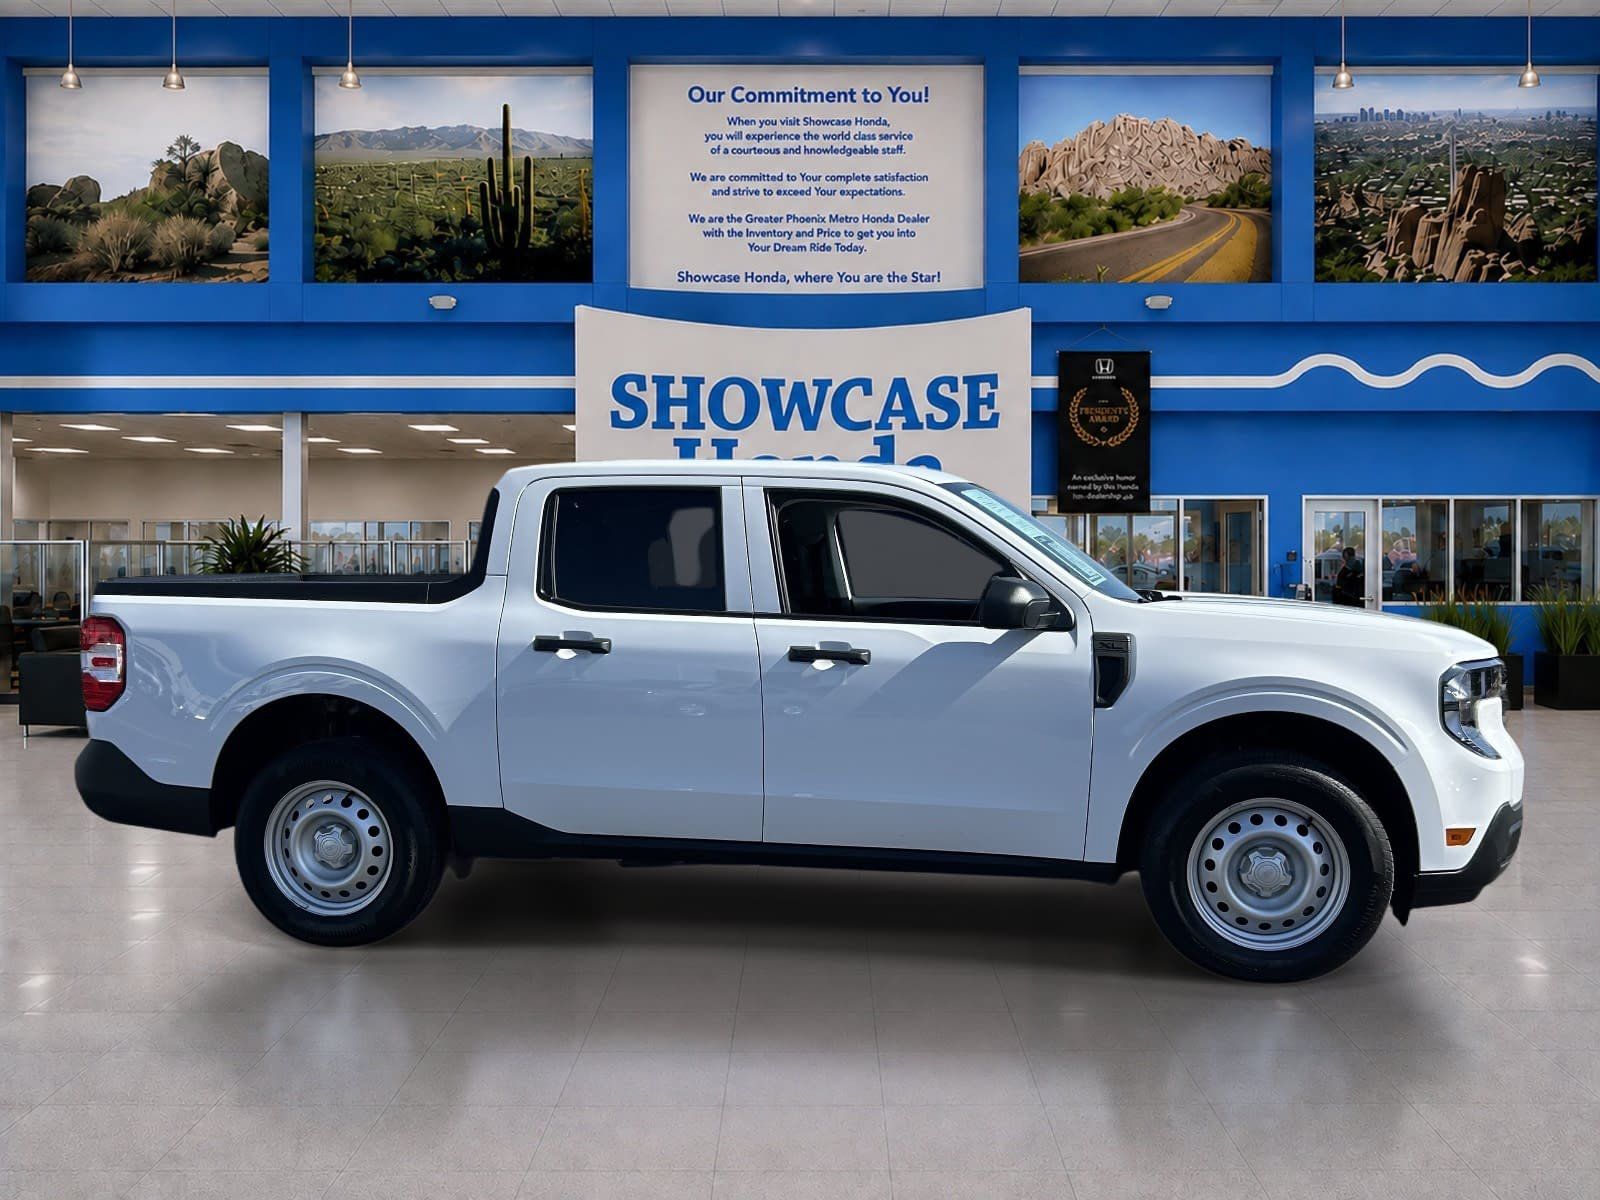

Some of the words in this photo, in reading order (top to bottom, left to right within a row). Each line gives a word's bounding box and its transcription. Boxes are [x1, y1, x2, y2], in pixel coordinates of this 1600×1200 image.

[687, 85, 726, 104] Our
[730, 85, 857, 104] Commitment
[860, 87, 883, 104] to
[886, 85, 930, 104] You!
[726, 116, 757, 127] When
[758, 118, 778, 128] you
[779, 116, 801, 127] visit
[802, 116, 853, 127] Showcase
[854, 116, 891, 128] Honda,
[704, 132, 724, 143] you
[725, 130, 743, 141] will
[745, 130, 801, 143] experience
[802, 130, 820, 141] the
[821, 130, 852, 141] world
[852, 130, 877, 142] class
[878, 130, 914, 142] service
[709, 144, 721, 155] of
[722, 146, 730, 156] a
[730, 146, 781, 156] courteous
[782, 144, 802, 155] and
[881, 144, 906, 155] staff.
[689, 172, 708, 183] We
[709, 174, 727, 182] are
[728, 171, 784, 183] committed
[785, 173, 798, 183] to
[799, 172, 823, 183] Your
[824, 172, 872, 185] complete
[873, 171, 929, 183] satisfaction
[711, 185, 731, 197] and
[732, 186, 761, 197] strive
[762, 187, 774, 197] to
[775, 186, 812, 197] exceed
[813, 186, 838, 197] Your
[839, 186, 906, 200] expectations.
[688, 213, 707, 224] We
[707, 215, 725, 224] are
[726, 213, 743, 224] the
[744, 213, 784, 224] Greater
[785, 213, 827, 224] Phoenix
[828, 213, 860, 224] Metro
[861, 213, 895, 224] Honda
[897, 213, 931, 224] Dealer
[702, 227, 725, 238] with
[726, 227, 744, 238] the
[745, 227, 794, 241] Inventory
[795, 227, 815, 239] and
[816, 227, 842, 239] Price
[843, 229, 855, 238] to
[856, 229, 874, 241] get
[875, 229, 895, 241] you
[896, 227, 917, 239] into
[747, 242, 772, 253] Your
[773, 242, 808, 253] Dream
[809, 242, 833, 253] Ride
[834, 242, 868, 255] Today.
[676, 270, 741, 284] Showcase
[744, 270, 790, 286] Honda,
[793, 270, 834, 284] where
[836, 271, 861, 284] You
[863, 273, 884, 284] are
[886, 270, 908, 284] the
[911, 270, 941, 284] Star!
[610, 372, 1001, 432] SHOWCASE
[1098, 641, 1124, 649] XL
